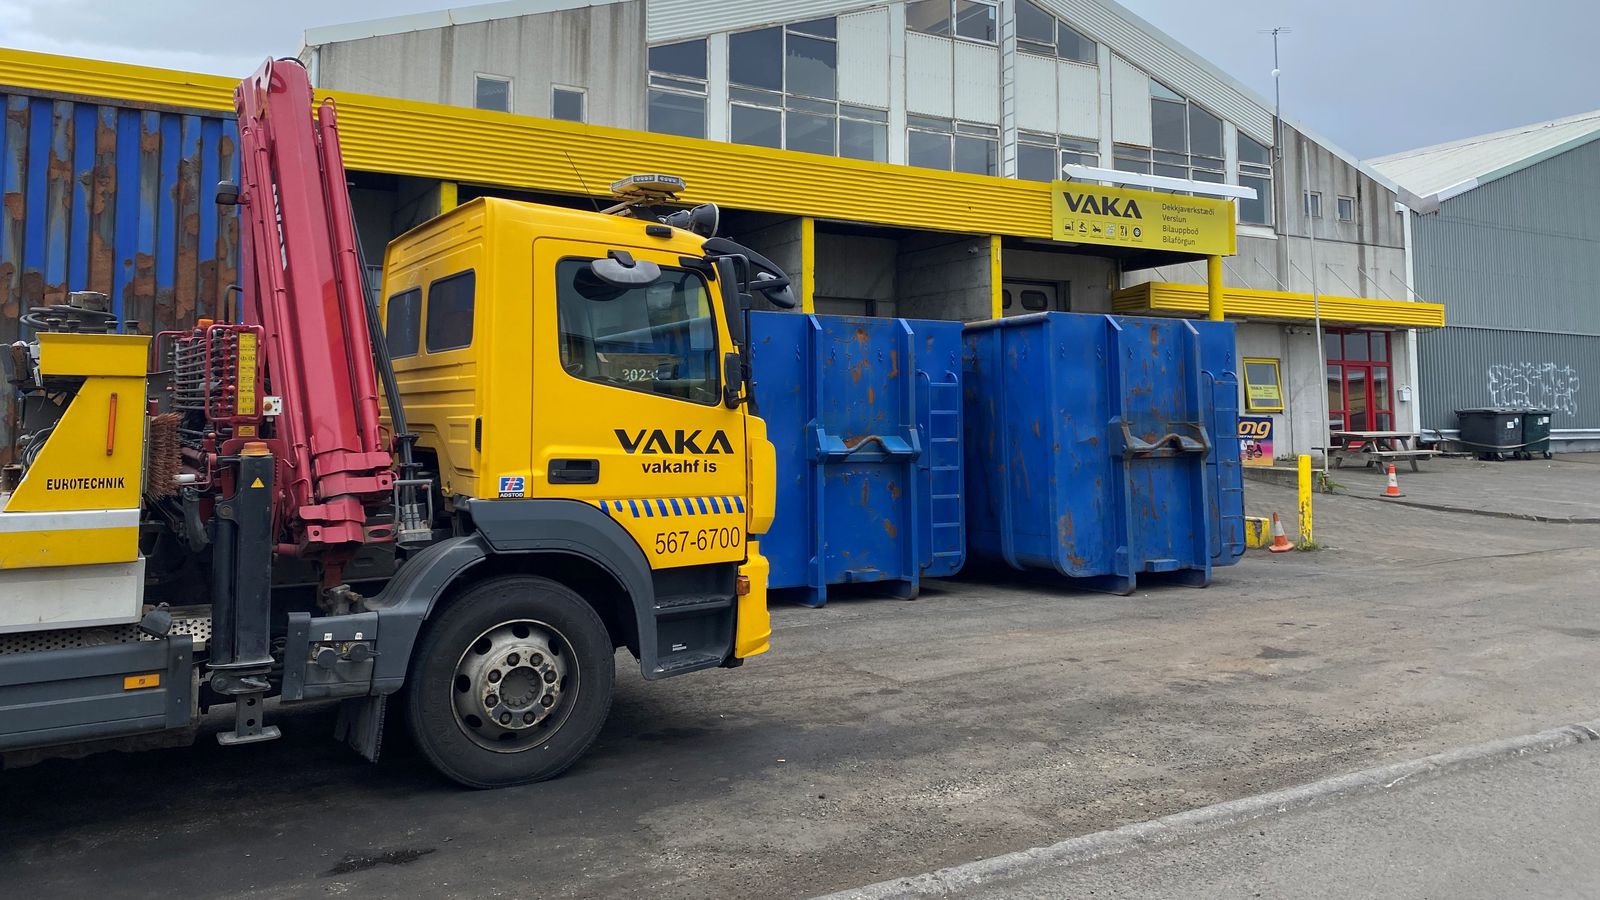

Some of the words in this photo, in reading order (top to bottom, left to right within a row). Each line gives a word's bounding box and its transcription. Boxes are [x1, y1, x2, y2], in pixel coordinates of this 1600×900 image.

[1063, 192, 1142, 219] VAKA
[1162, 214, 1187, 223] Verslun
[614, 430, 734, 454] VAKA
[46, 477, 125, 491] EUROTECHNIK
[655, 527, 740, 555] 567-6700
